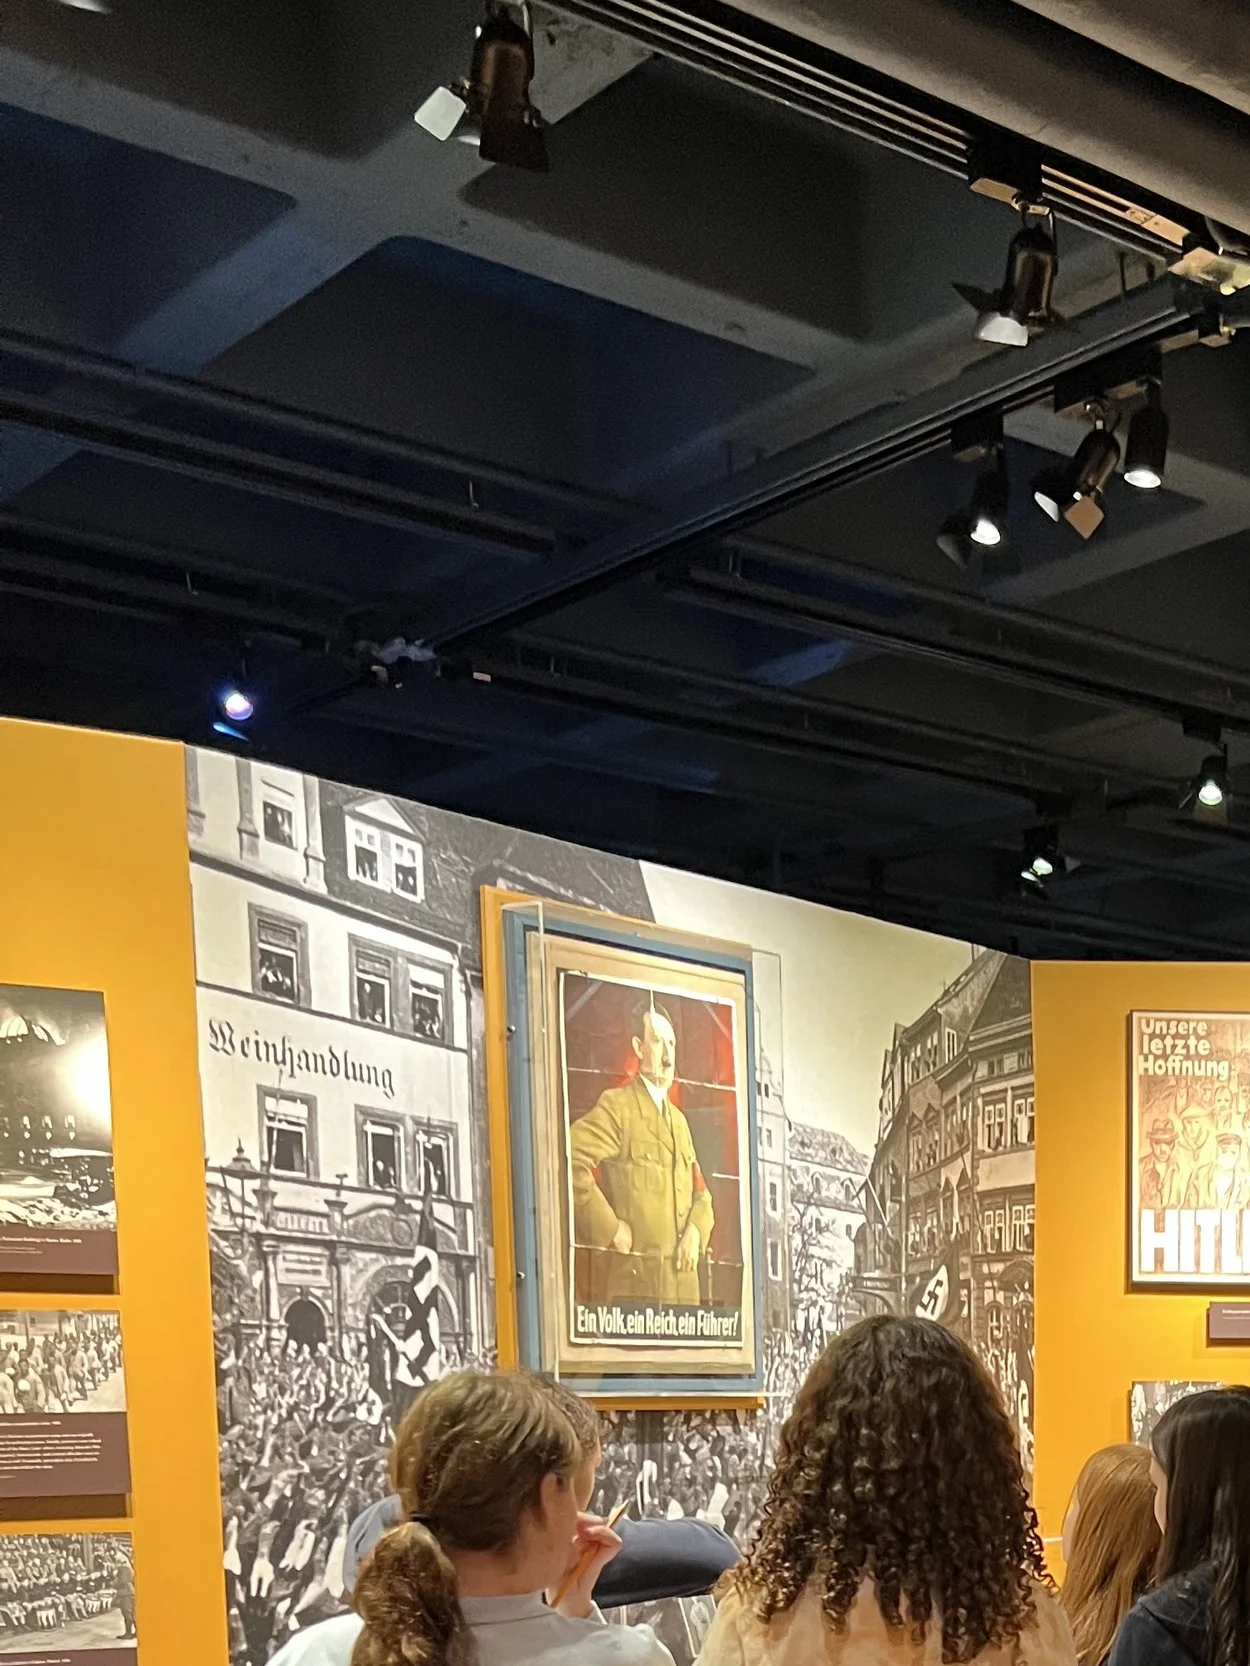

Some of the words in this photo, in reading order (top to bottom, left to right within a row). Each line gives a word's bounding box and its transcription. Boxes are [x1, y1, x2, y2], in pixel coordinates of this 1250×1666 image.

[1140, 1018, 1208, 1036] Unsere
[1142, 1034, 1211, 1056] letzte
[209, 1019, 395, 1099] Weinhandlung
[576, 1305, 597, 1333] Ein
[626, 1310, 645, 1335] ein
[678, 1312, 696, 1336] ein
[696, 1309, 739, 1338] Führer!
